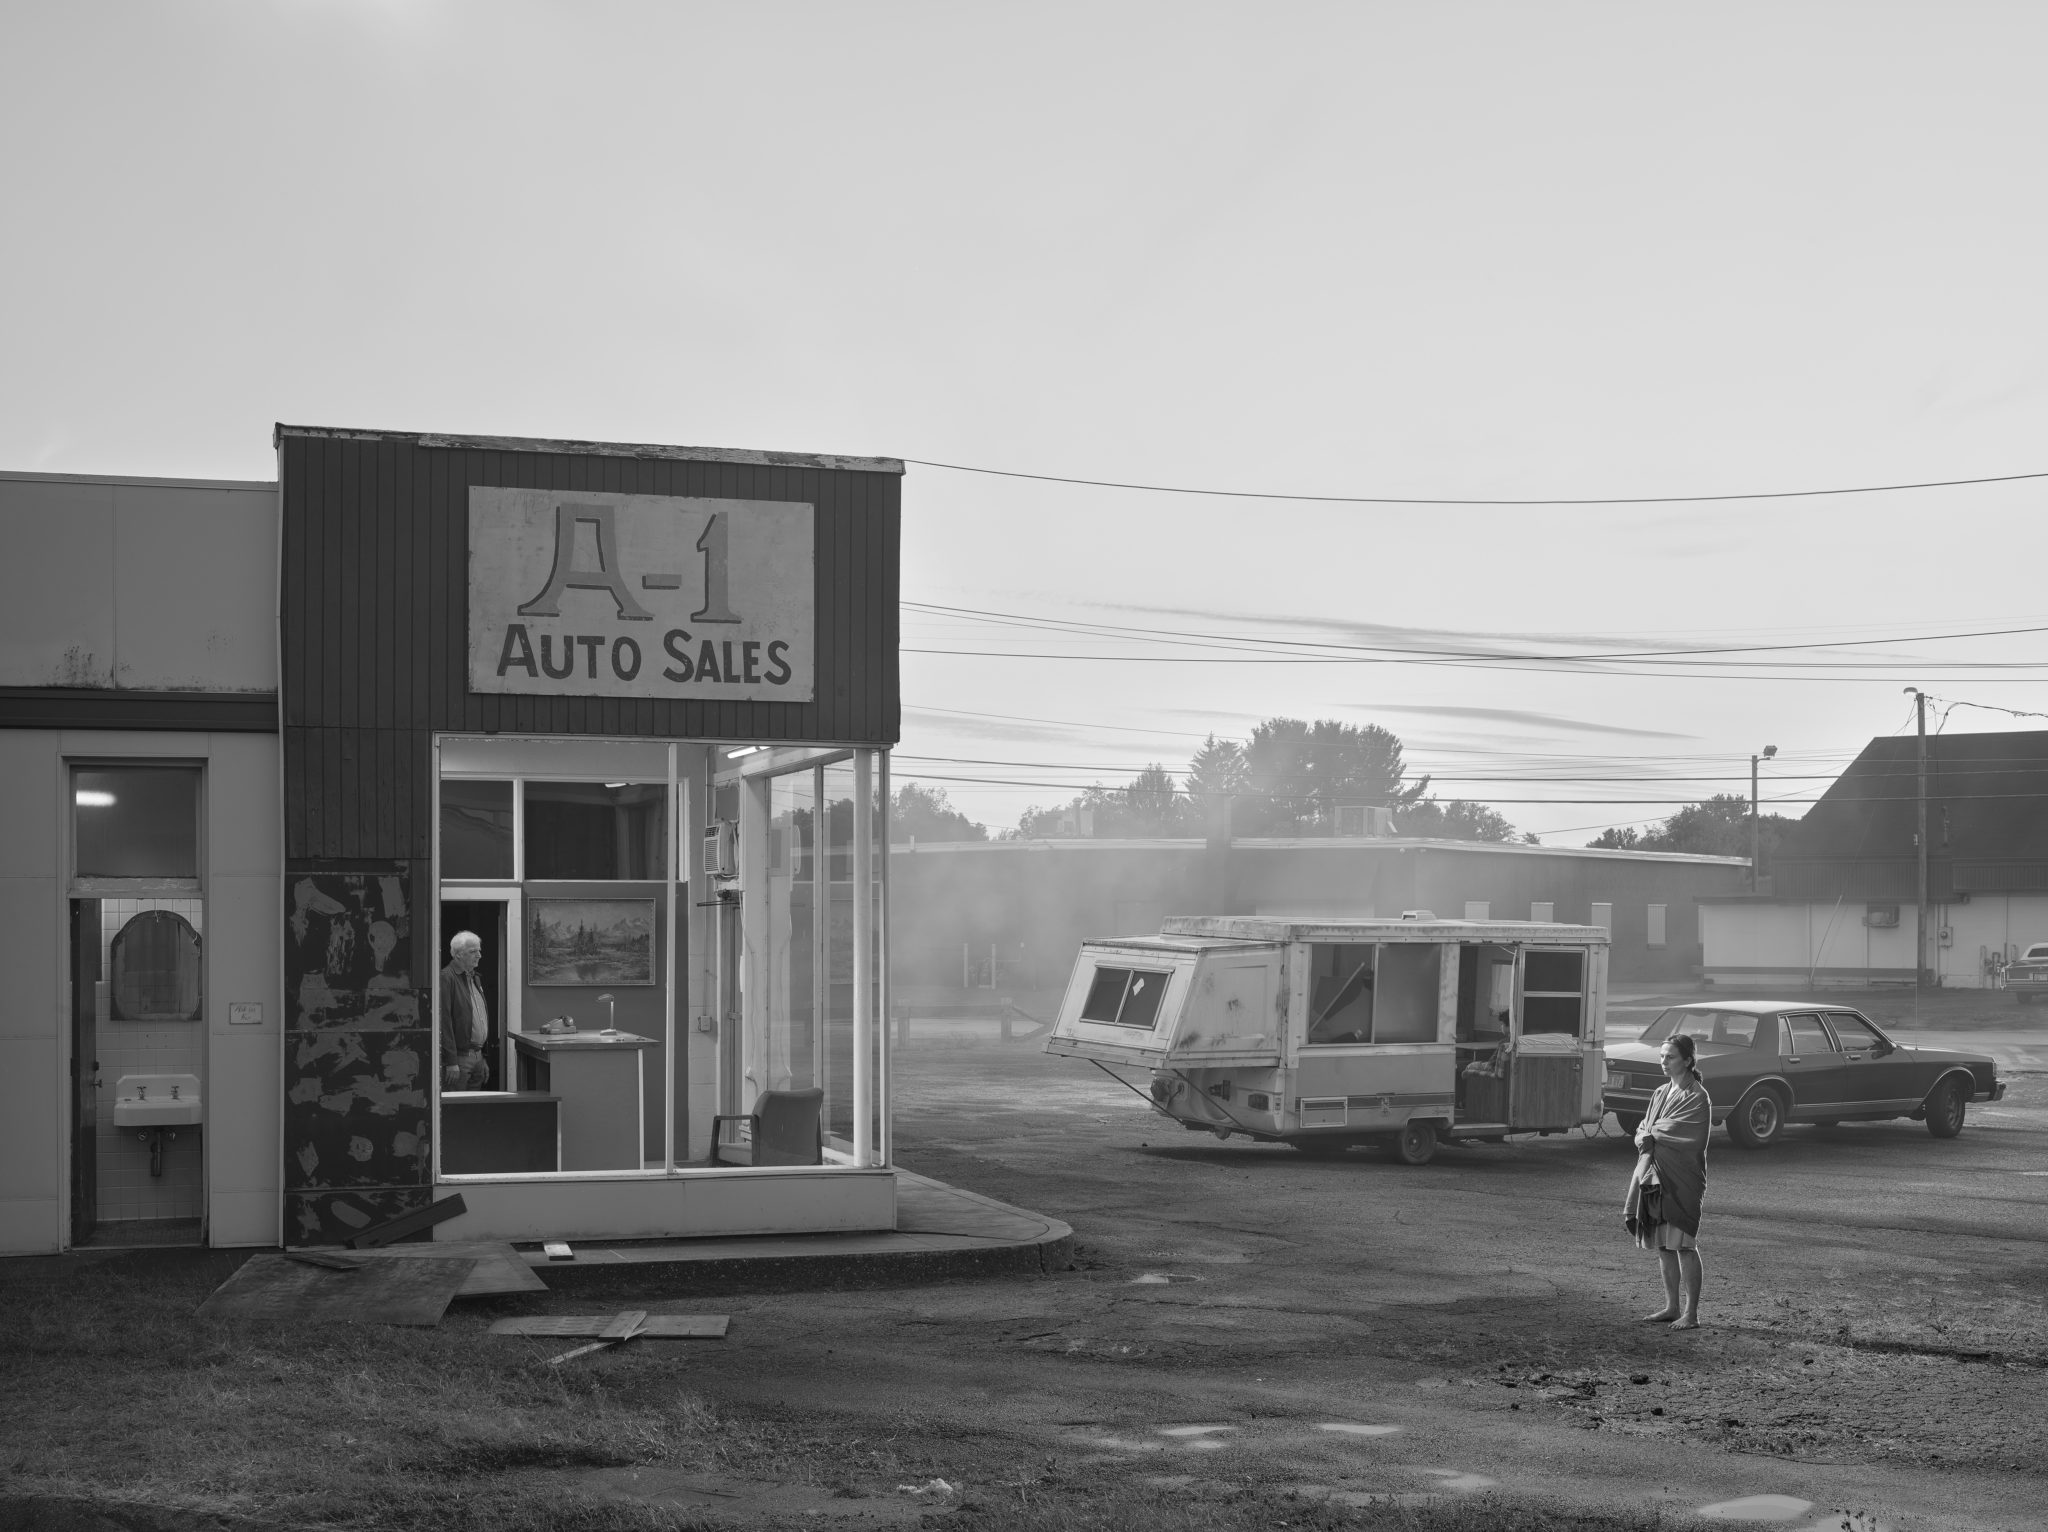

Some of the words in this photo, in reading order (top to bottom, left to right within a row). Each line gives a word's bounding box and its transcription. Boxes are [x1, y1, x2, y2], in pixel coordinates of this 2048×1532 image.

[517, 502, 742, 624] A-1
[496, 623, 642, 682] AUTO
[662, 628, 792, 686] SALES
